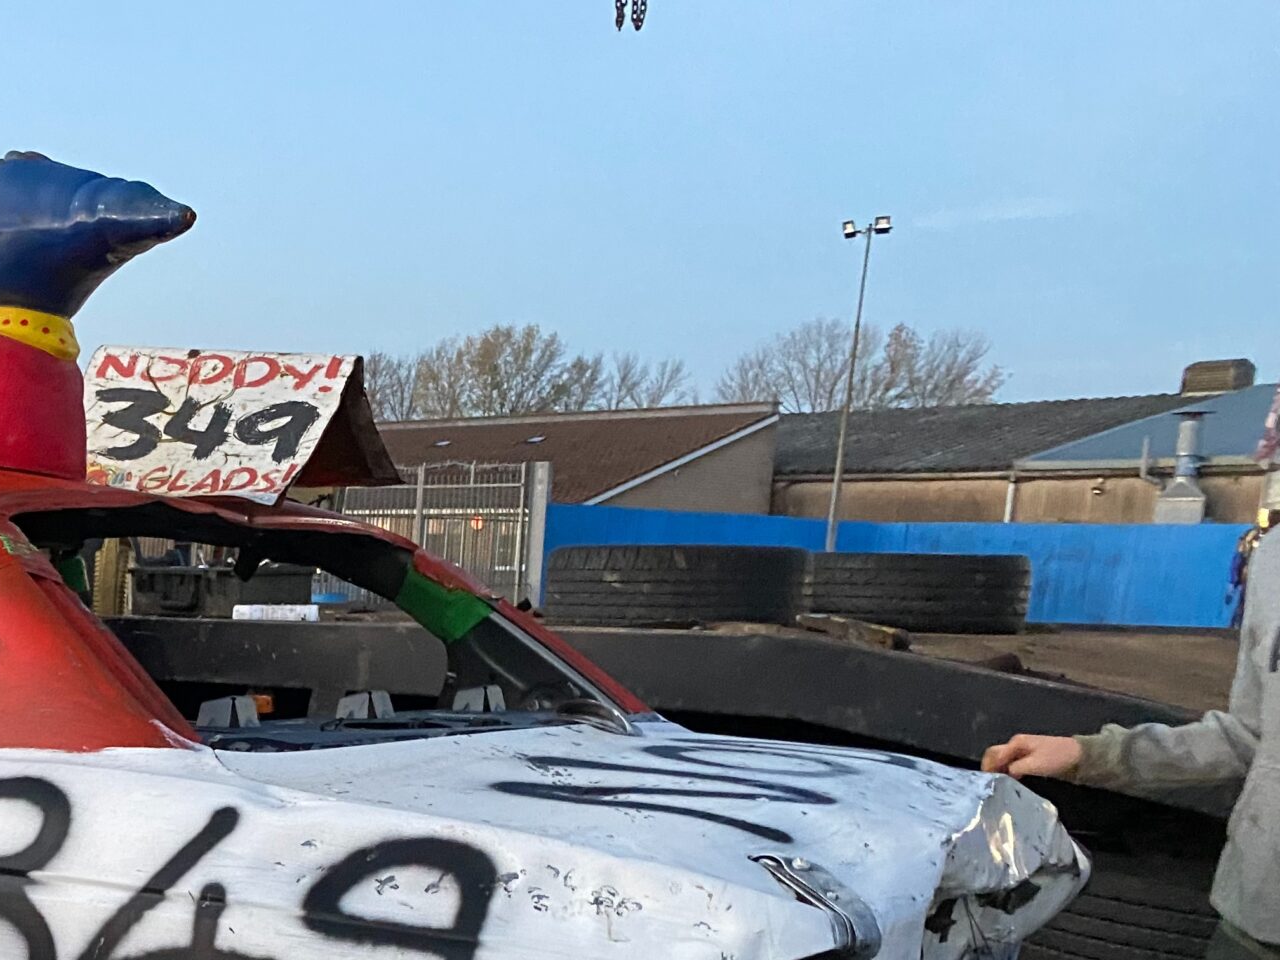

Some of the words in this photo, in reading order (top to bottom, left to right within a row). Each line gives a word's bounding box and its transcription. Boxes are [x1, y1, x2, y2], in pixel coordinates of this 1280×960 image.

[95, 353, 344, 393] NODDY!
[95, 386, 320, 464] 349
[135, 463, 298, 494] GLADS!
